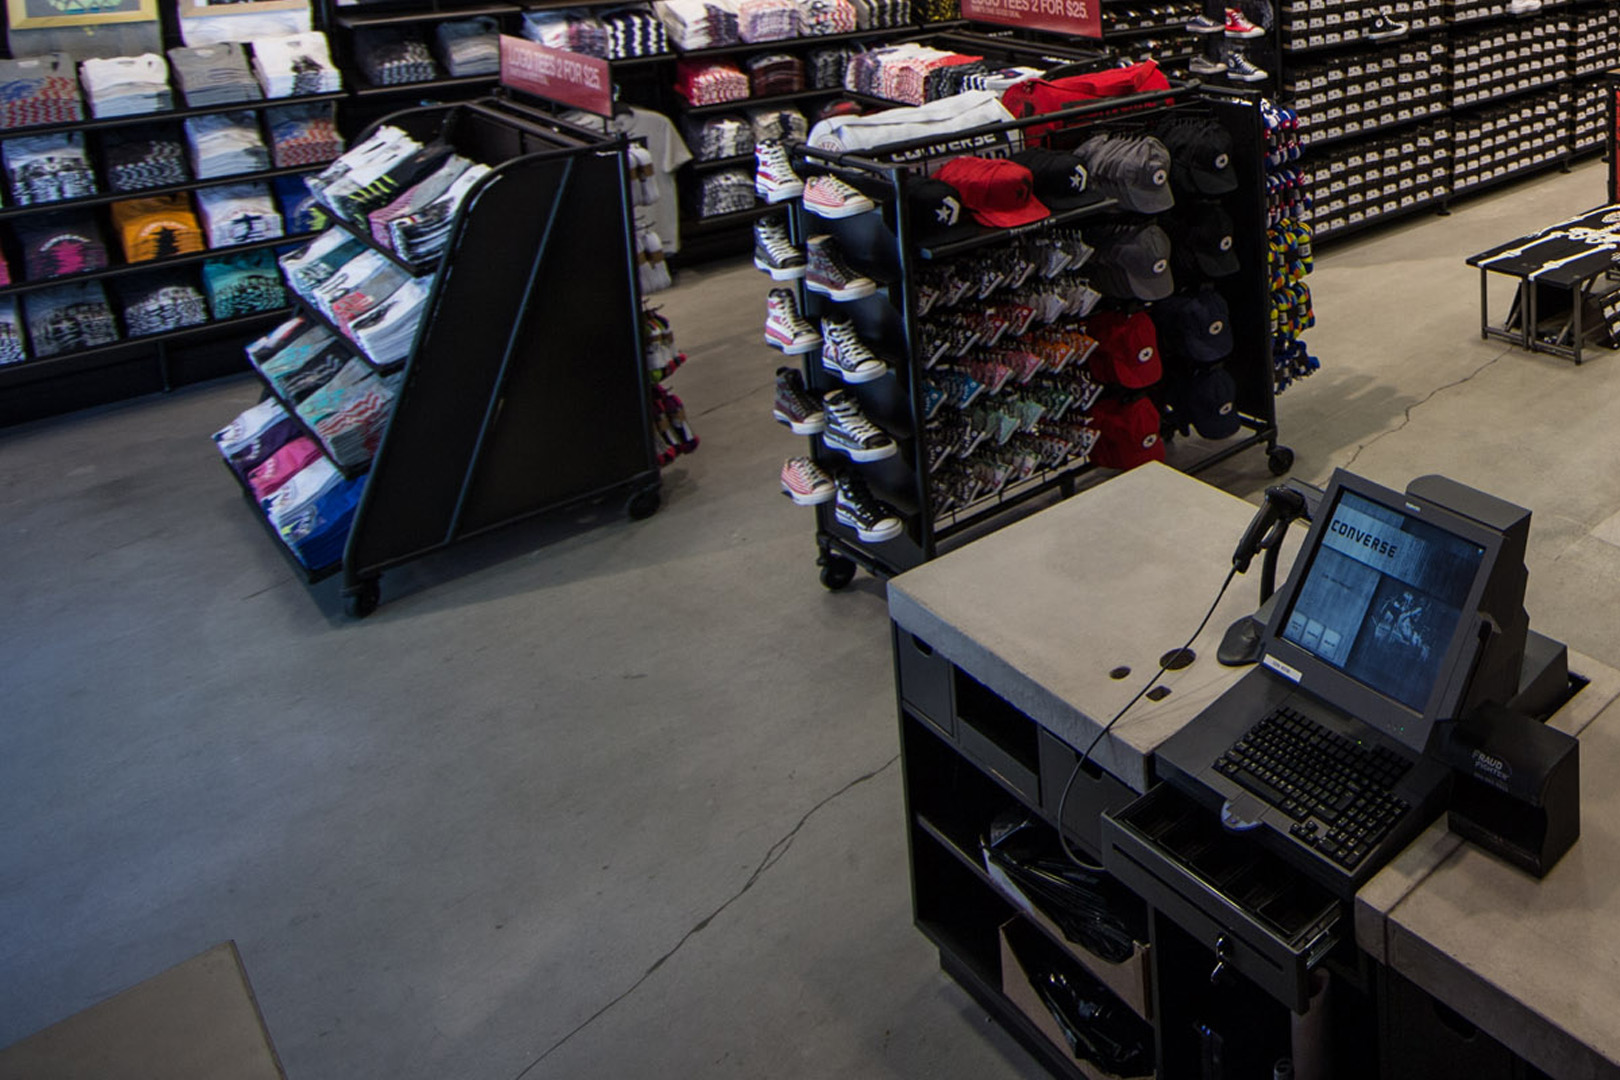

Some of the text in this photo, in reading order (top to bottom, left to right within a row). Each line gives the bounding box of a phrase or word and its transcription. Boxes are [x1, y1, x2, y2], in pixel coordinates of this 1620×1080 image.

[1066, 0, 1089, 19] $25.
[564, 60, 582, 84] FOR
[1331, 519, 1398, 559] CONVERSE
[1471, 749, 1503, 770] FRAUD
